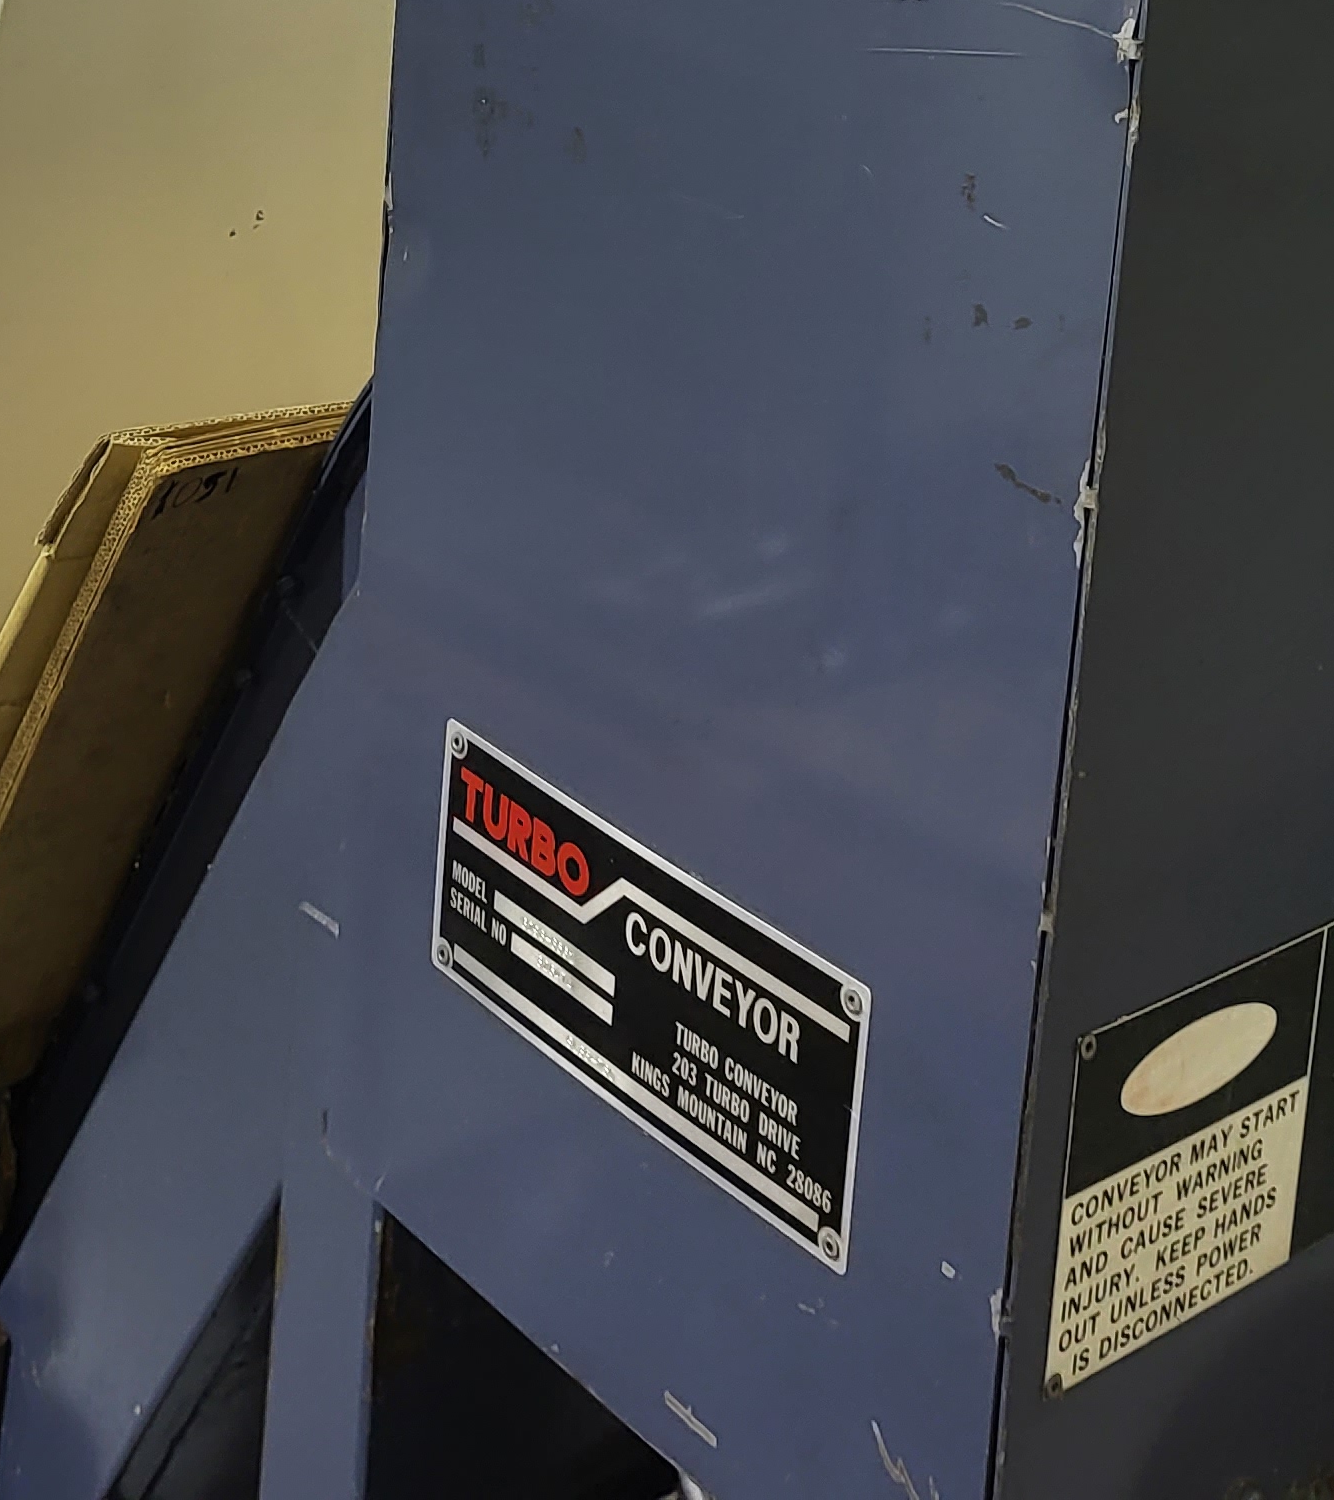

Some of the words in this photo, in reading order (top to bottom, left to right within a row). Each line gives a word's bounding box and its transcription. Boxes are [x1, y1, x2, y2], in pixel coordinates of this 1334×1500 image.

[452, 860, 489, 905] MODEL
[460, 767, 590, 897] TURBO
[449, 888, 489, 933] SERIAL
[491, 917, 507, 947] NO
[625, 911, 801, 1064] CONVEYOR
[631, 1051, 670, 1097] KINGS
[677, 1089, 747, 1154] MOUNTAIN
[757, 1143, 777, 1173] NC
[787, 1163, 832, 1214] 28086
[672, 1053, 697, 1086] 203
[704, 1072, 750, 1124] TURBO
[759, 1112, 800, 1160] DRIVE
[675, 1021, 719, 1071] TURBO
[724, 1053, 798, 1127] CONVEYOR
[1068, 1192, 1162, 1258] WITHOUT
[1176, 1139, 1264, 1202] WARNING
[1071, 1152, 1182, 1227] CONVEYOR
[1190, 1124, 1235, 1164] MAY
[1240, 1089, 1301, 1140] START
[1058, 1315, 1100, 1353] OUT
[1110, 1265, 1187, 1323] UNLESS
[1196, 1224, 1262, 1279] POWER
[1060, 1270, 1141, 1323] INJURY.
[1156, 1228, 1206, 1273] KEEP
[1213, 1187, 1278, 1239] HANDS
[1064, 1251, 1109, 1291] AND
[1120, 1210, 1186, 1265] CAUSE
[1196, 1165, 1268, 1218] SEVERE
[1071, 1346, 1090, 1375] IS
[1099, 1258, 1254, 1360] DISCONNECTED.
